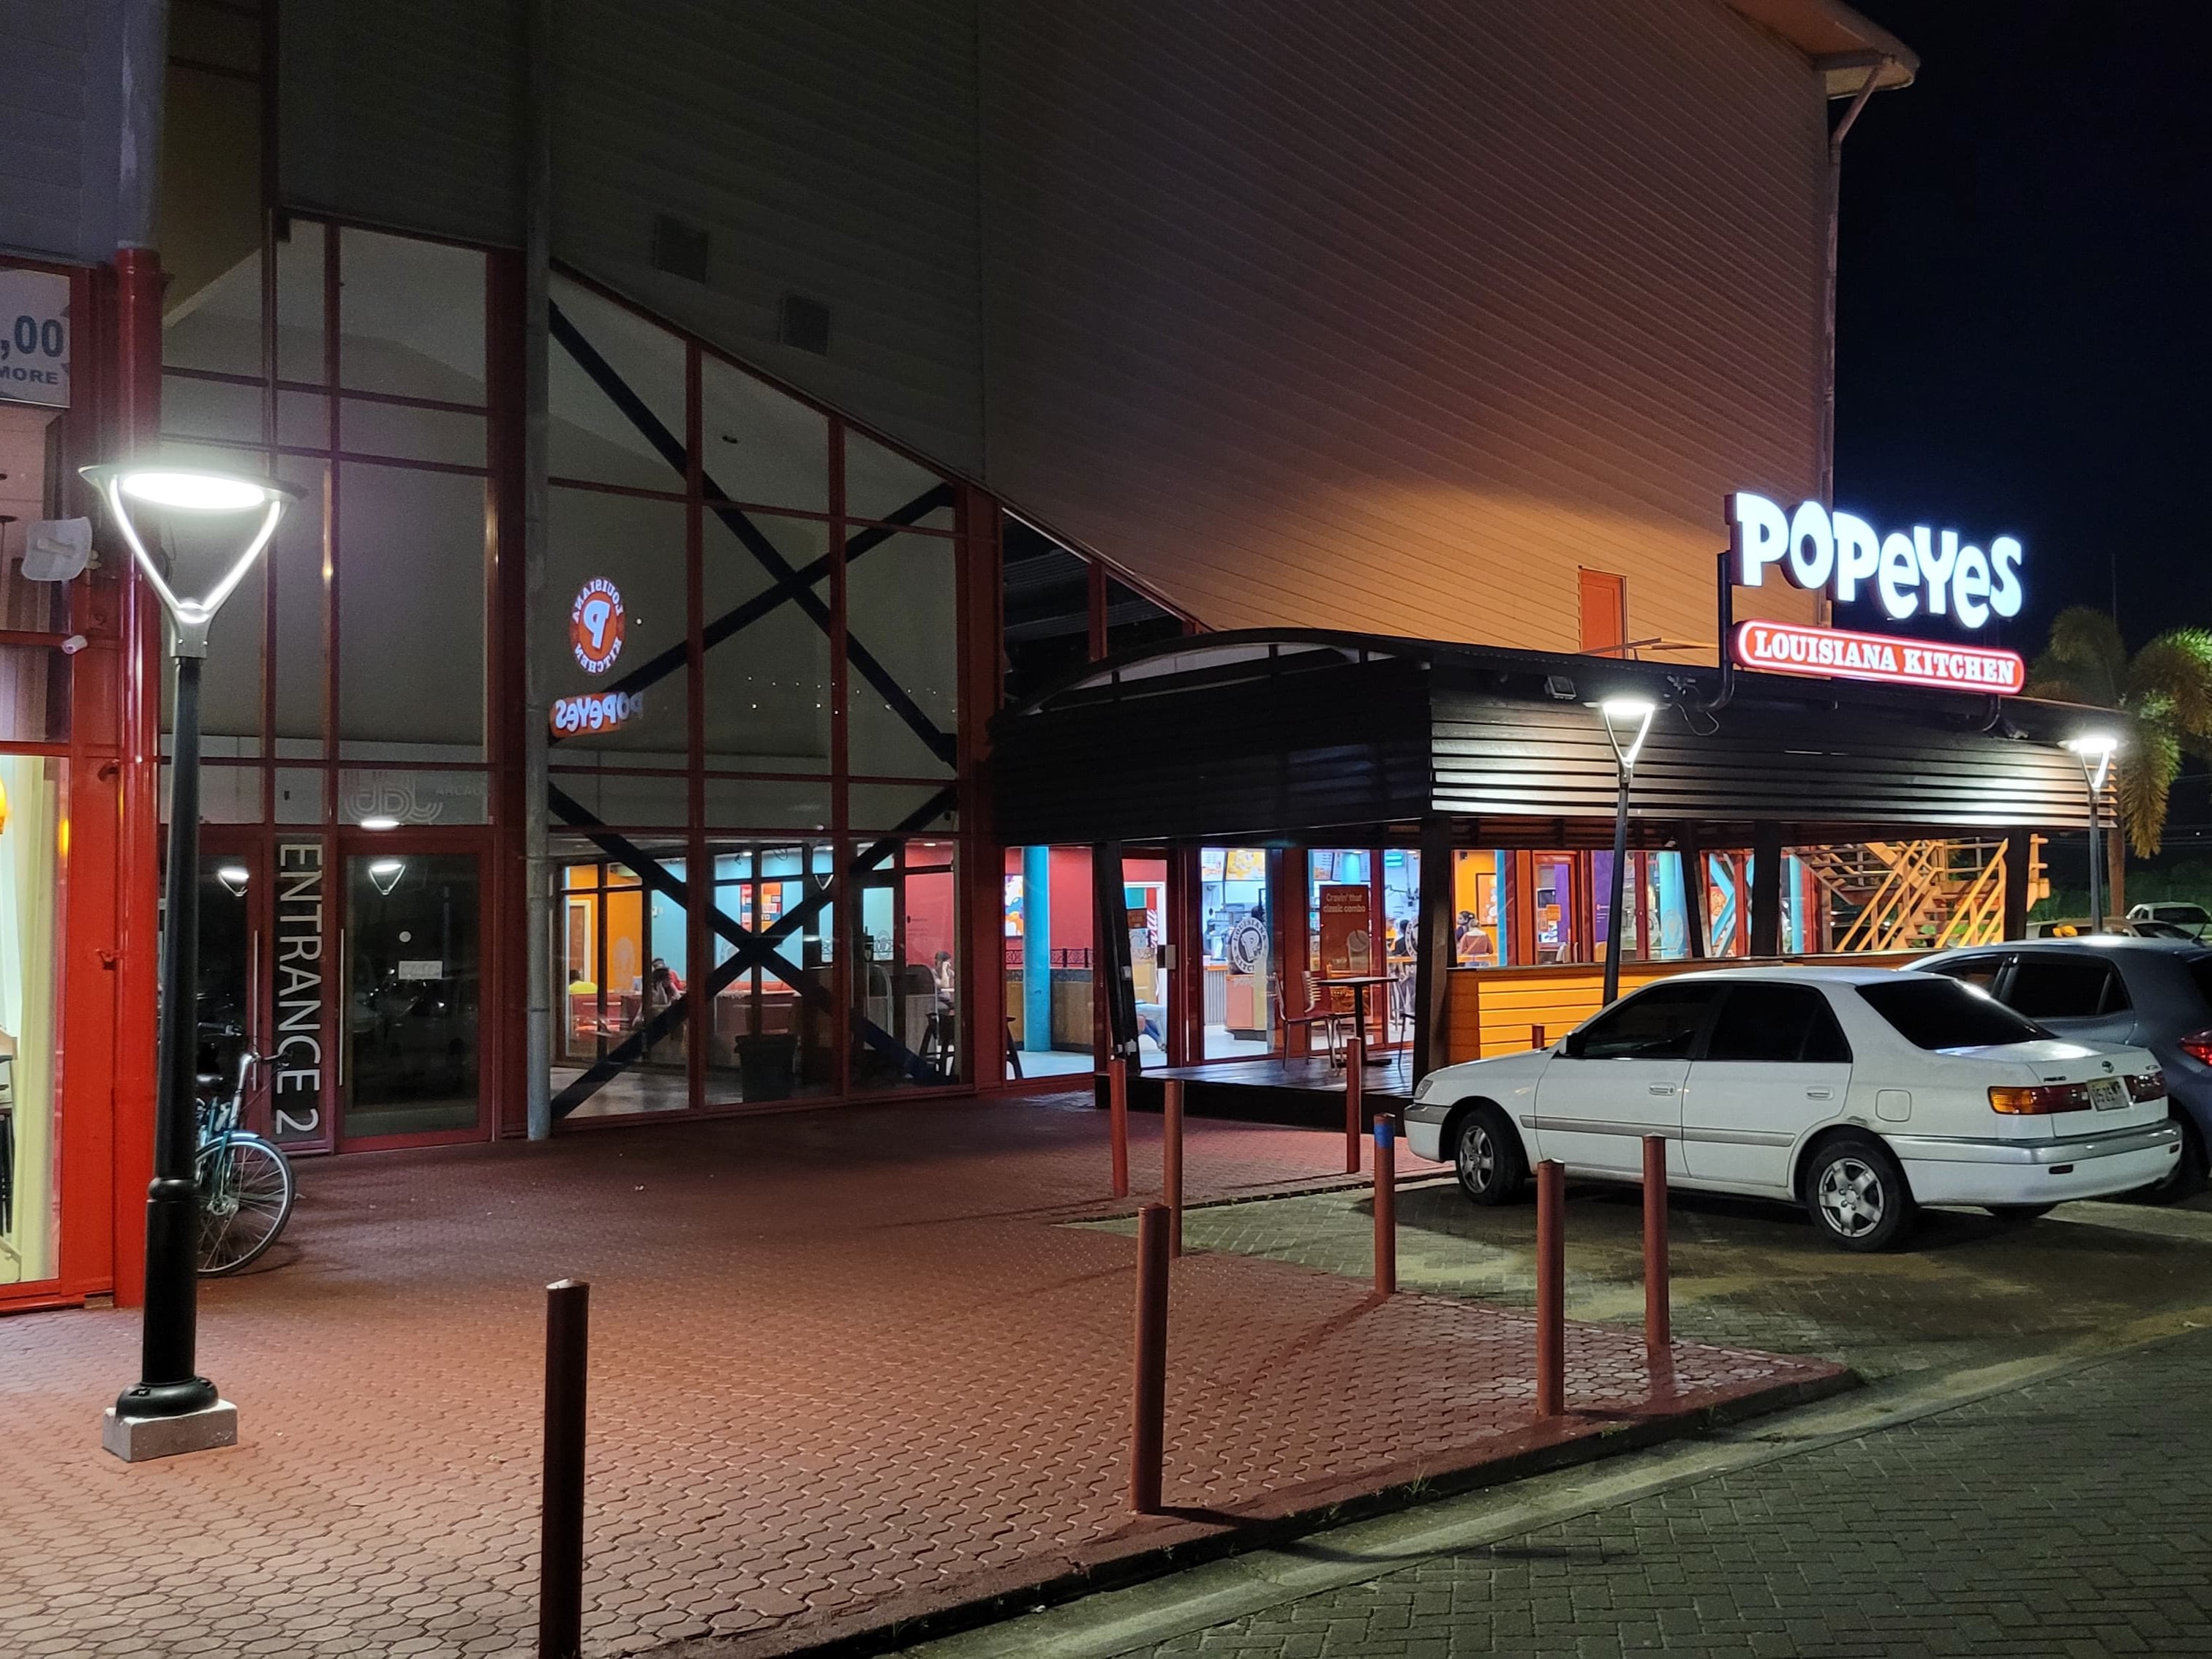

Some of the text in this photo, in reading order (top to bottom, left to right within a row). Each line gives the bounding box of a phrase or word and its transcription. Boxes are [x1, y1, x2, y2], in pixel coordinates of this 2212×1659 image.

[1754, 630, 2016, 685] LOUISIANA KITCHEN
[1344, 903, 1366, 913] combo
[1233, 919, 1267, 941] LOUISIANA
[275, 843, 323, 1135] ENTRANCE 2
